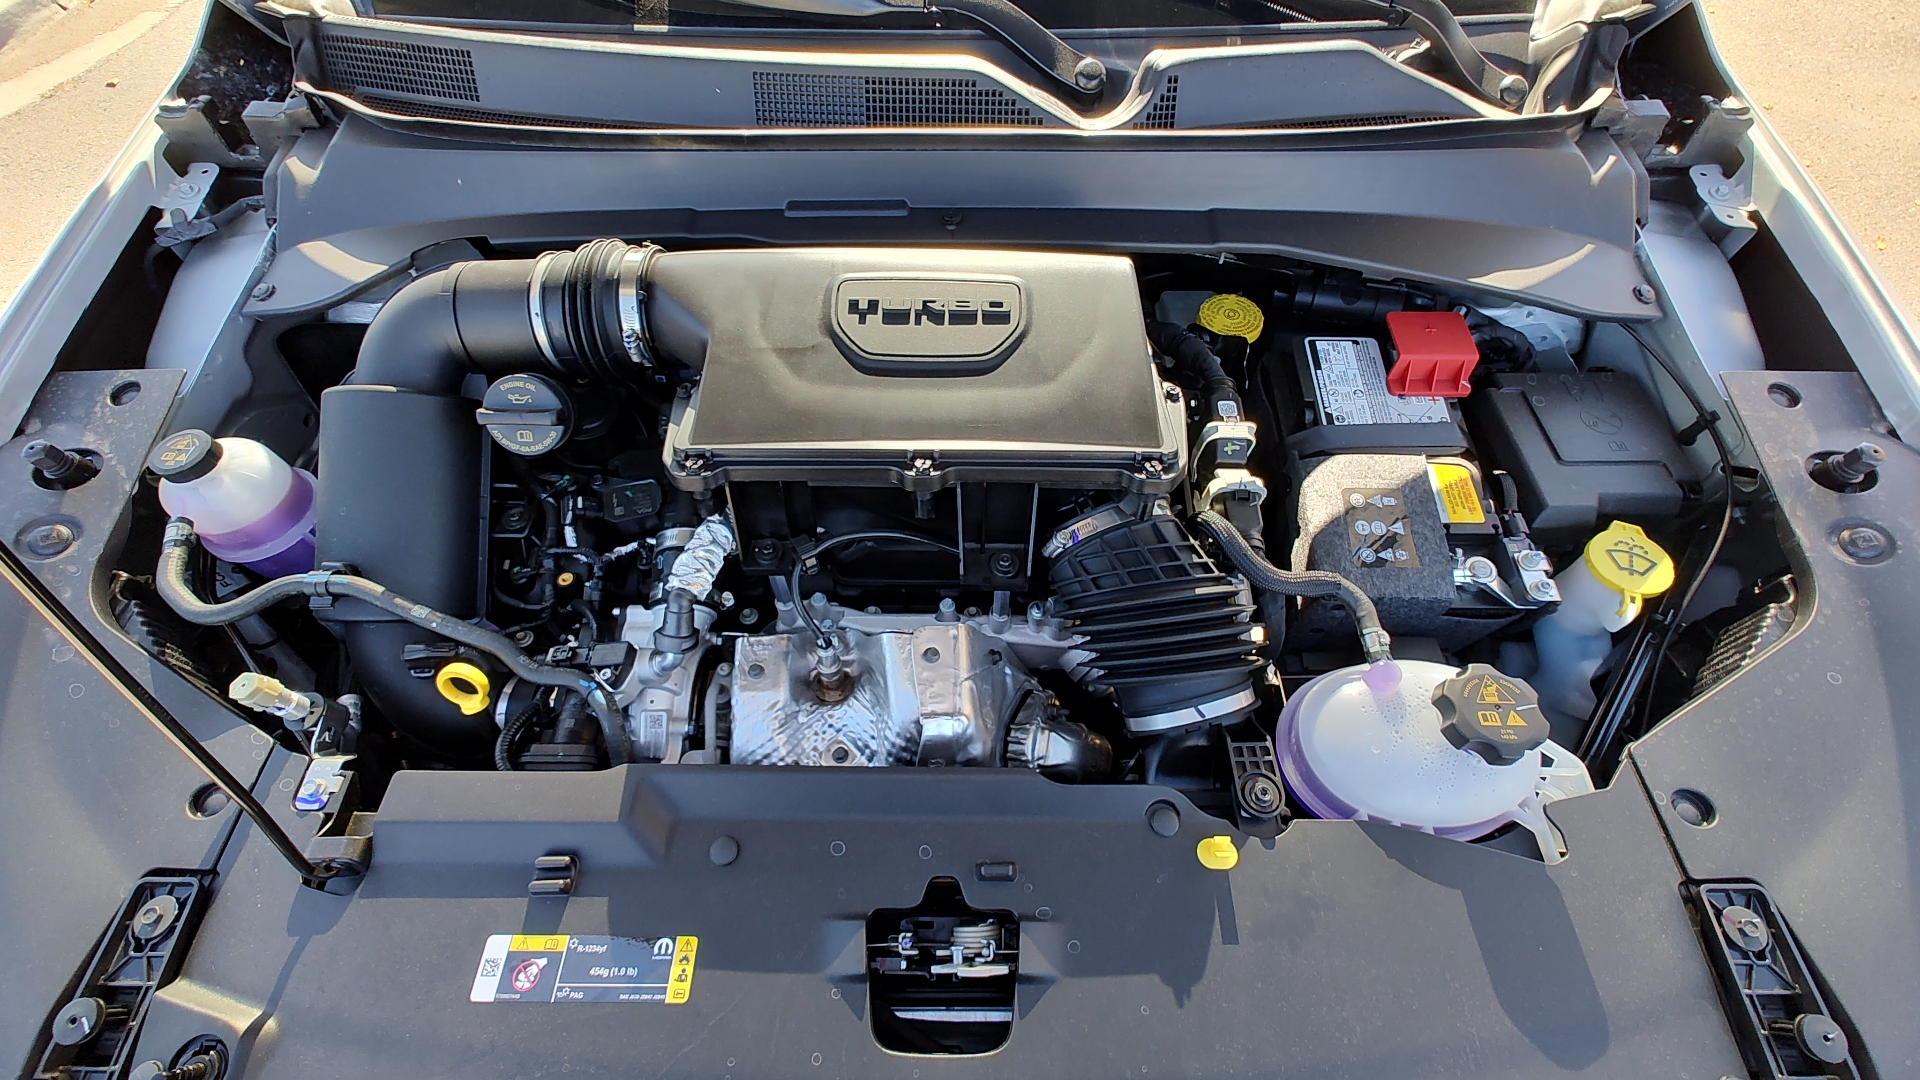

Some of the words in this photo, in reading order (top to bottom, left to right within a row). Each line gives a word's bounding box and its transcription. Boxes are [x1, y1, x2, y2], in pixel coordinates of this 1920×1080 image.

[848, 298, 1011, 326] TURBO
[500, 381, 525, 391] ENGINE
[525, 382, 537, 392] OIL
[491, 430, 502, 440] API
[576, 944, 608, 954] R-1234yf
[589, 967, 609, 978] 454g
[610, 967, 626, 977] (1.0
[626, 967, 638, 977] lb)
[569, 991, 584, 999] PAG
